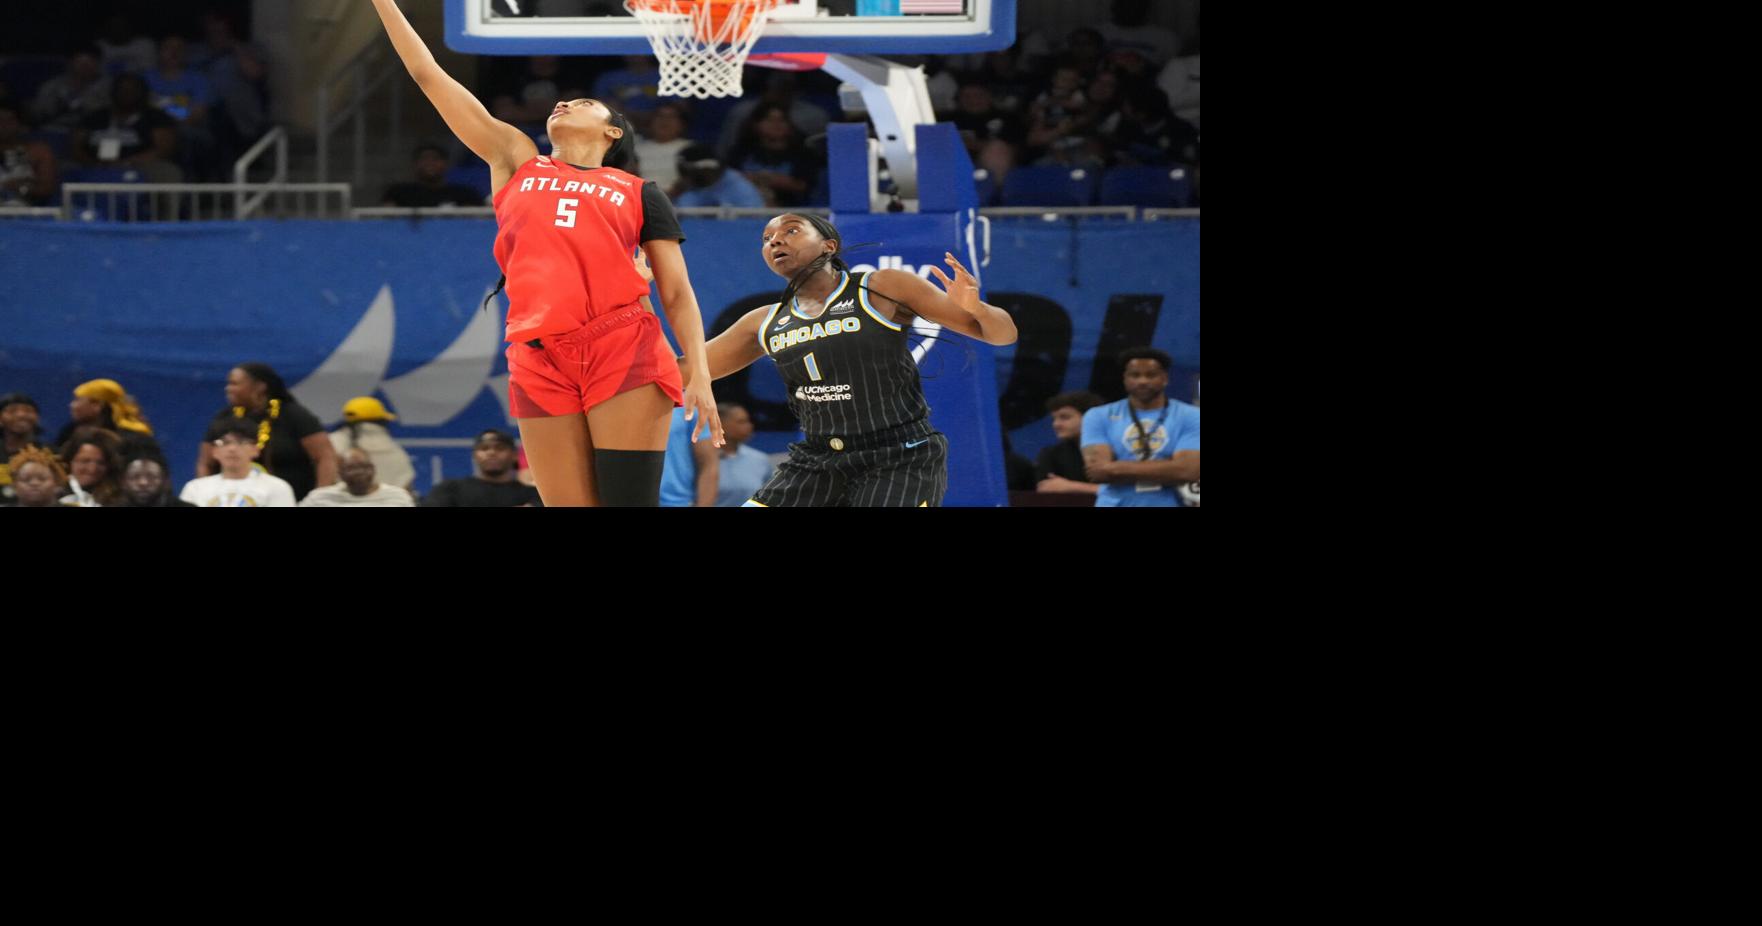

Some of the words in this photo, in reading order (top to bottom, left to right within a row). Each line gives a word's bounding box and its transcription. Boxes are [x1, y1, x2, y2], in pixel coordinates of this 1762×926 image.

[520, 177, 625, 206] ATLANTA
[555, 198, 579, 228] 5
[770, 317, 861, 353] CHICAGO
[803, 352, 822, 381] 1
[804, 384, 850, 394] UChicago
[808, 393, 851, 402] Medicine
